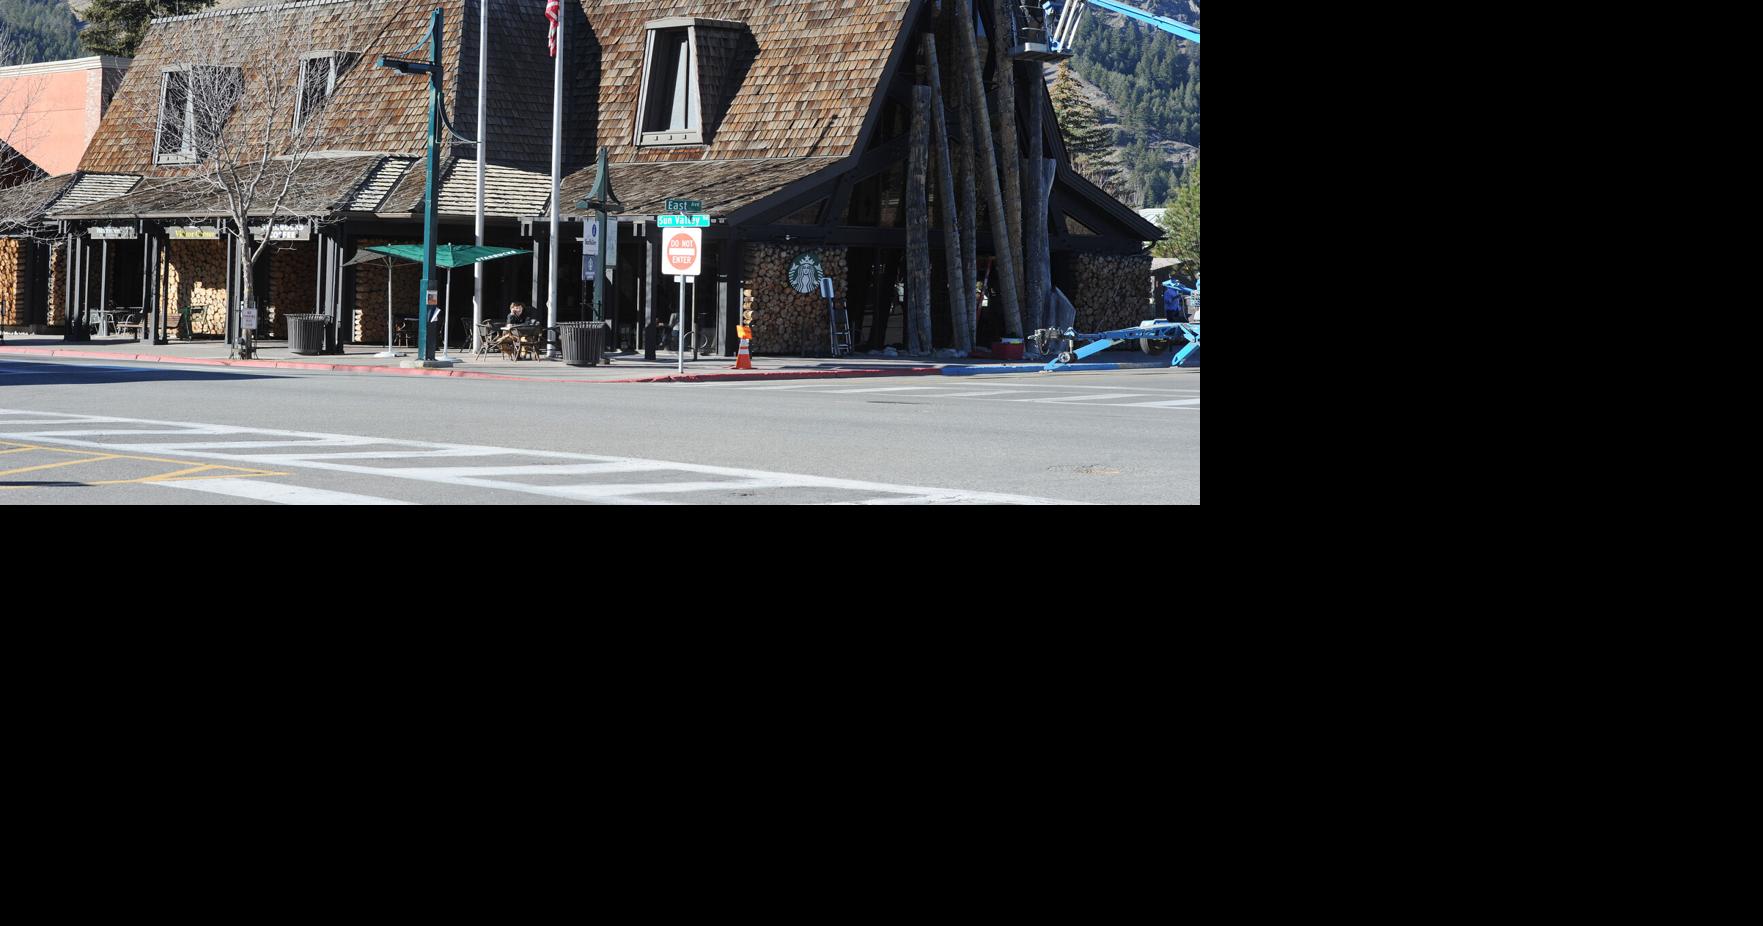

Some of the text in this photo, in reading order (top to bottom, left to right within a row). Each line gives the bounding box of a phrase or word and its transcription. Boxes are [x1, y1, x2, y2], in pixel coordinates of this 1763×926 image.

[668, 200, 687, 210] East
[659, 216, 672, 225] Sun
[675, 215, 700, 226] Valley
[671, 240, 693, 248] DO NOT
[672, 256, 692, 264] ENTER
